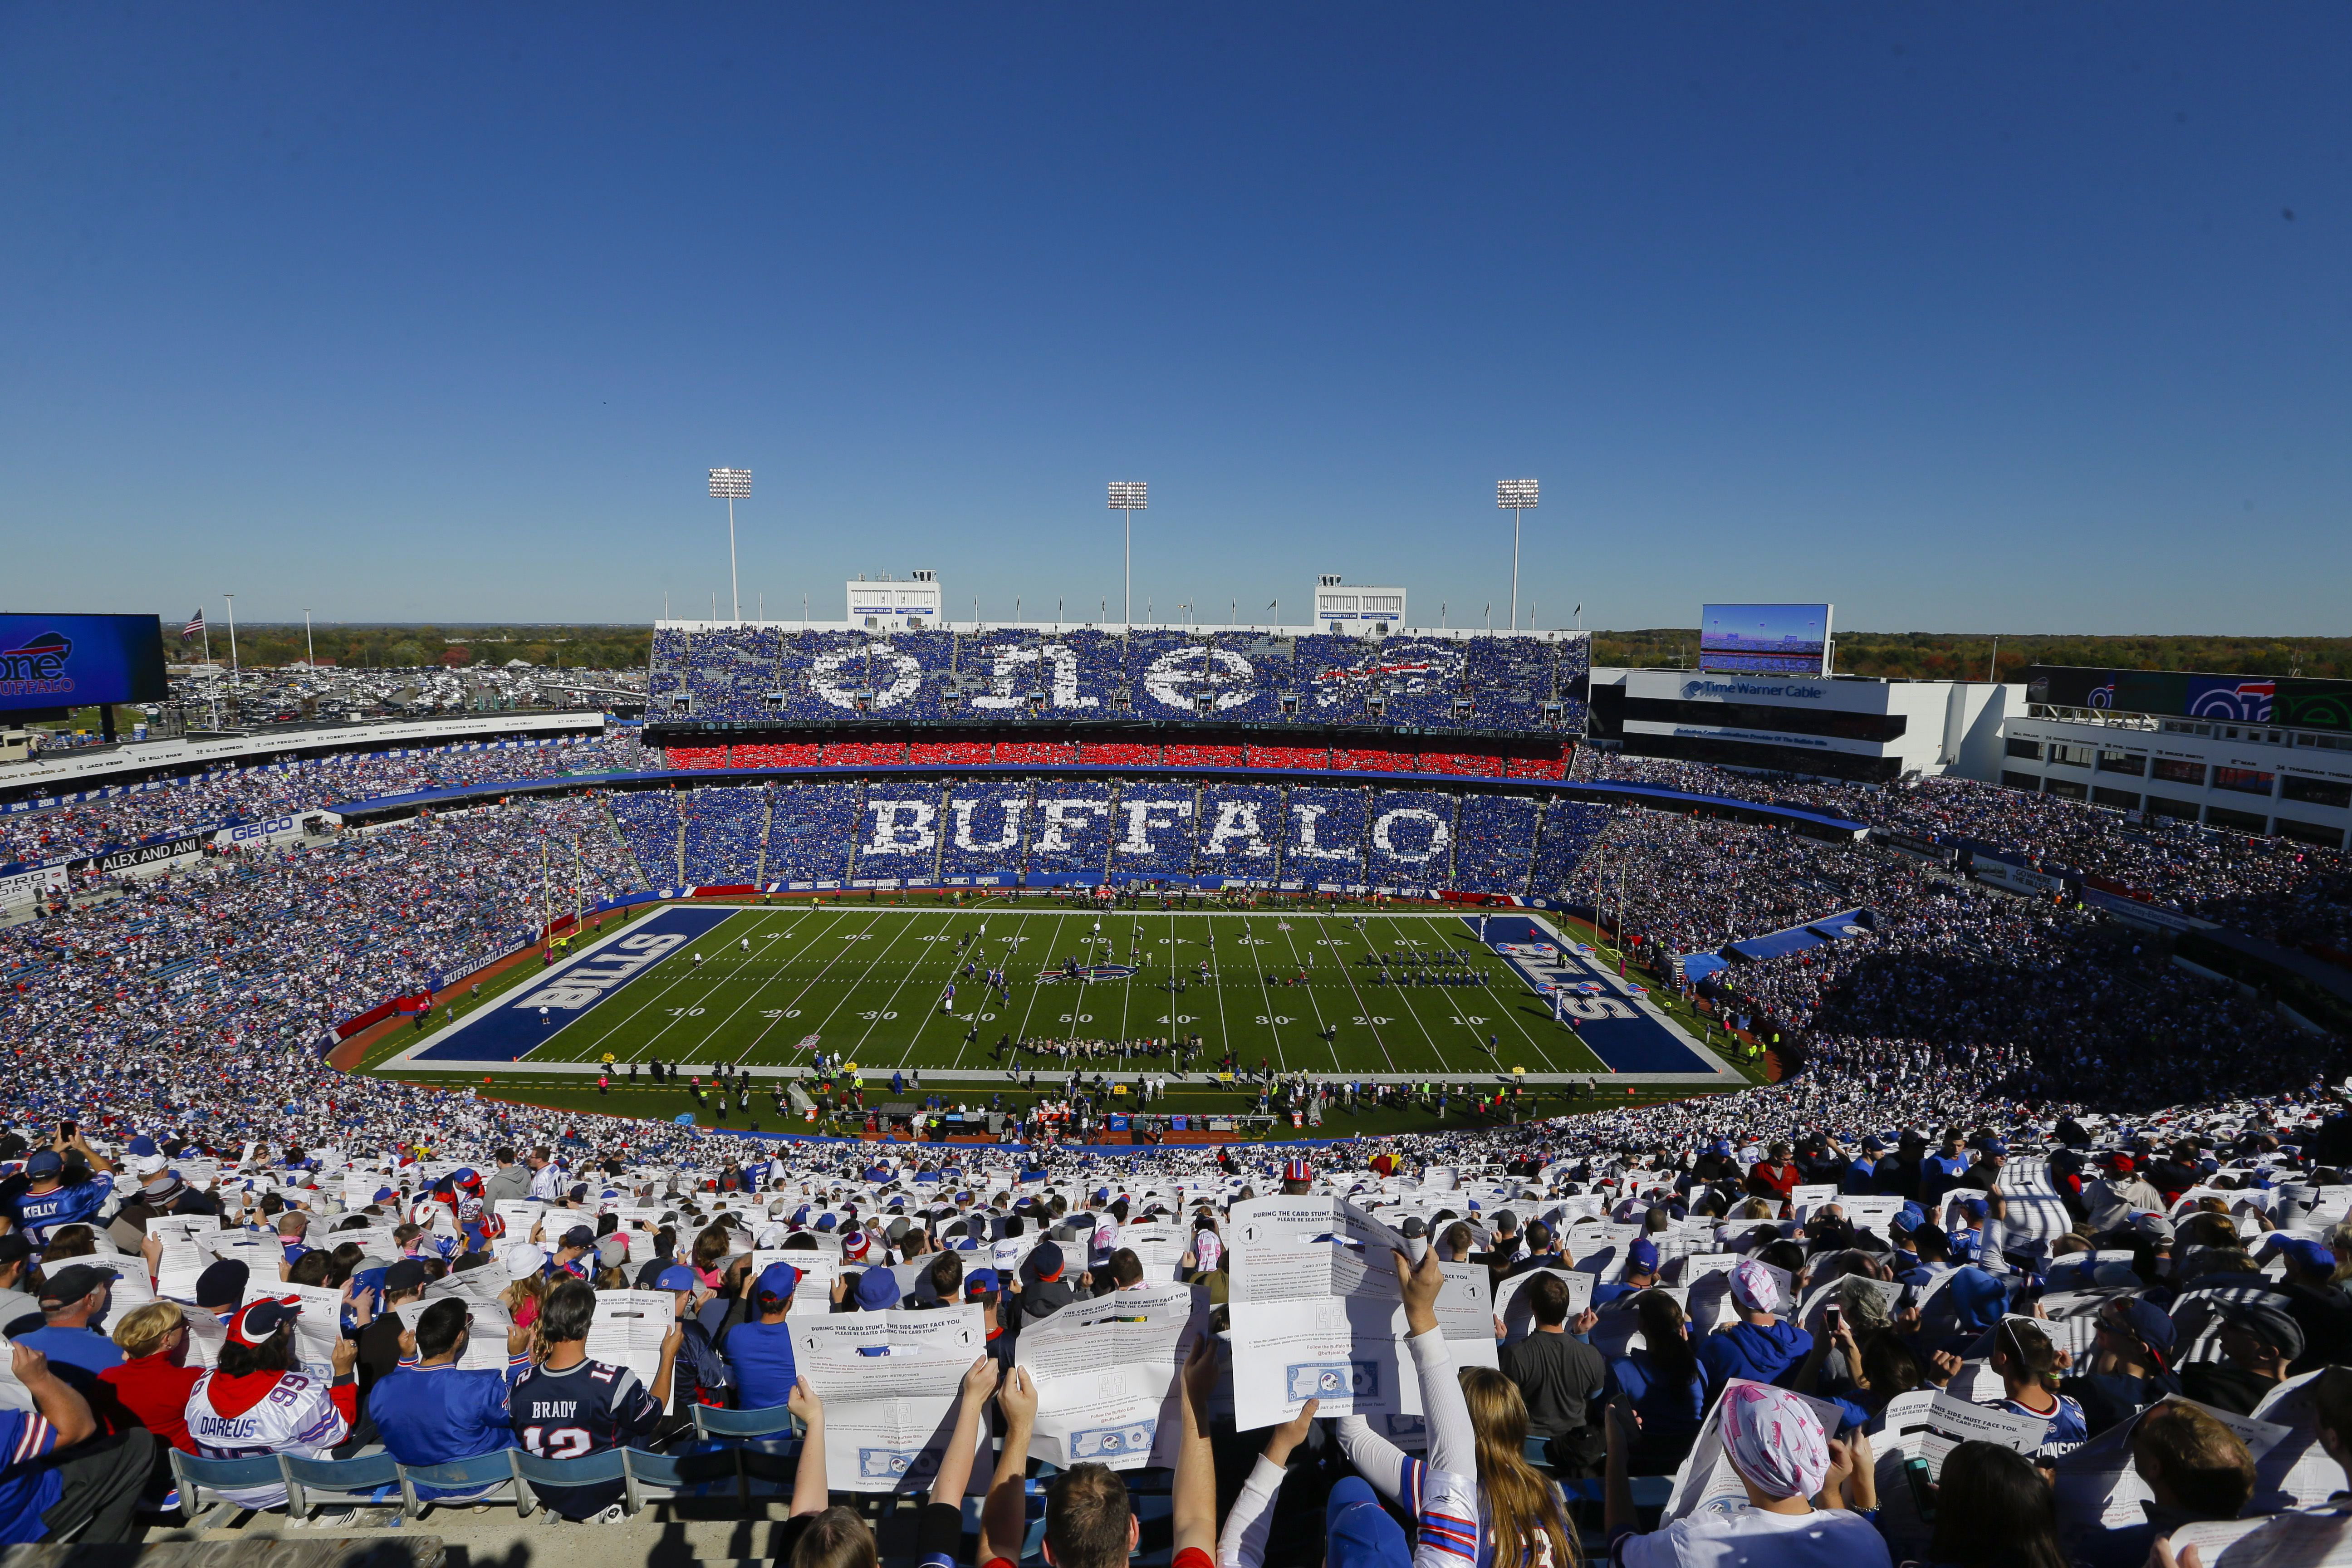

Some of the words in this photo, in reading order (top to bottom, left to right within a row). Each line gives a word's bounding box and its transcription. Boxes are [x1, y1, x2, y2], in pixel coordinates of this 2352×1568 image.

[0, 654, 65, 681] one
[811, 642, 1254, 710] one
[0, 678, 74, 696] UFFALO
[1704, 681, 1735, 694] Time
[1738, 682, 1785, 696] Warner
[1786, 685, 1821, 700] Cable
[321, 757, 336, 765] Blue
[209, 771, 222, 781] Blue
[2288, 766, 2325, 775] THURMAN
[129, 783, 144, 795] Blue
[146, 782, 160, 790] 200
[85, 789, 101, 802] Blue
[108, 786, 122, 799] Blue
[380, 788, 416, 798] BLUEZONE
[11, 802, 29, 812] 244
[38, 798, 55, 808] 200
[179, 823, 218, 838] BLUEZONE
[231, 816, 293, 842] GEICO
[862, 799, 1452, 863] BUFFALO
[1901, 837, 1912, 845] YOUR
[1912, 840, 1924, 849] OWN
[1924, 845, 1936, 853] FLAG
[102, 853, 137, 871] ALEX
[139, 845, 170, 863] AND
[172, 839, 196, 855] ANI
[2012, 874, 2024, 883] THE
[0, 882, 46, 897] ORTS
[443, 939, 526, 986] BUFFALOBILLS.com
[513, 933, 687, 1009] BILLS
[669, 1008, 706, 1017] 10
[763, 1009, 801, 1019] 20
[863, 1011, 898, 1020] 30
[959, 1012, 996, 1022] 40
[1058, 1014, 1093, 1023] 50
[1156, 1015, 1192, 1024] 40
[1255, 1015, 1289, 1025] 30
[1352, 1016, 1387, 1025] 20
[1450, 1016, 1483, 1025] 10
[23, 1202, 58, 1219] KELLY
[1333, 1211, 1346, 1219] THIS
[1245, 1227, 1252, 1240] 1
[961, 1331, 969, 1343] 1
[807, 1338, 814, 1349] 1
[270, 1372, 310, 1407] 99
[532, 1401, 578, 1419] BRADY
[200, 1415, 257, 1438] DAREUS
[523, 1426, 592, 1460] 12
